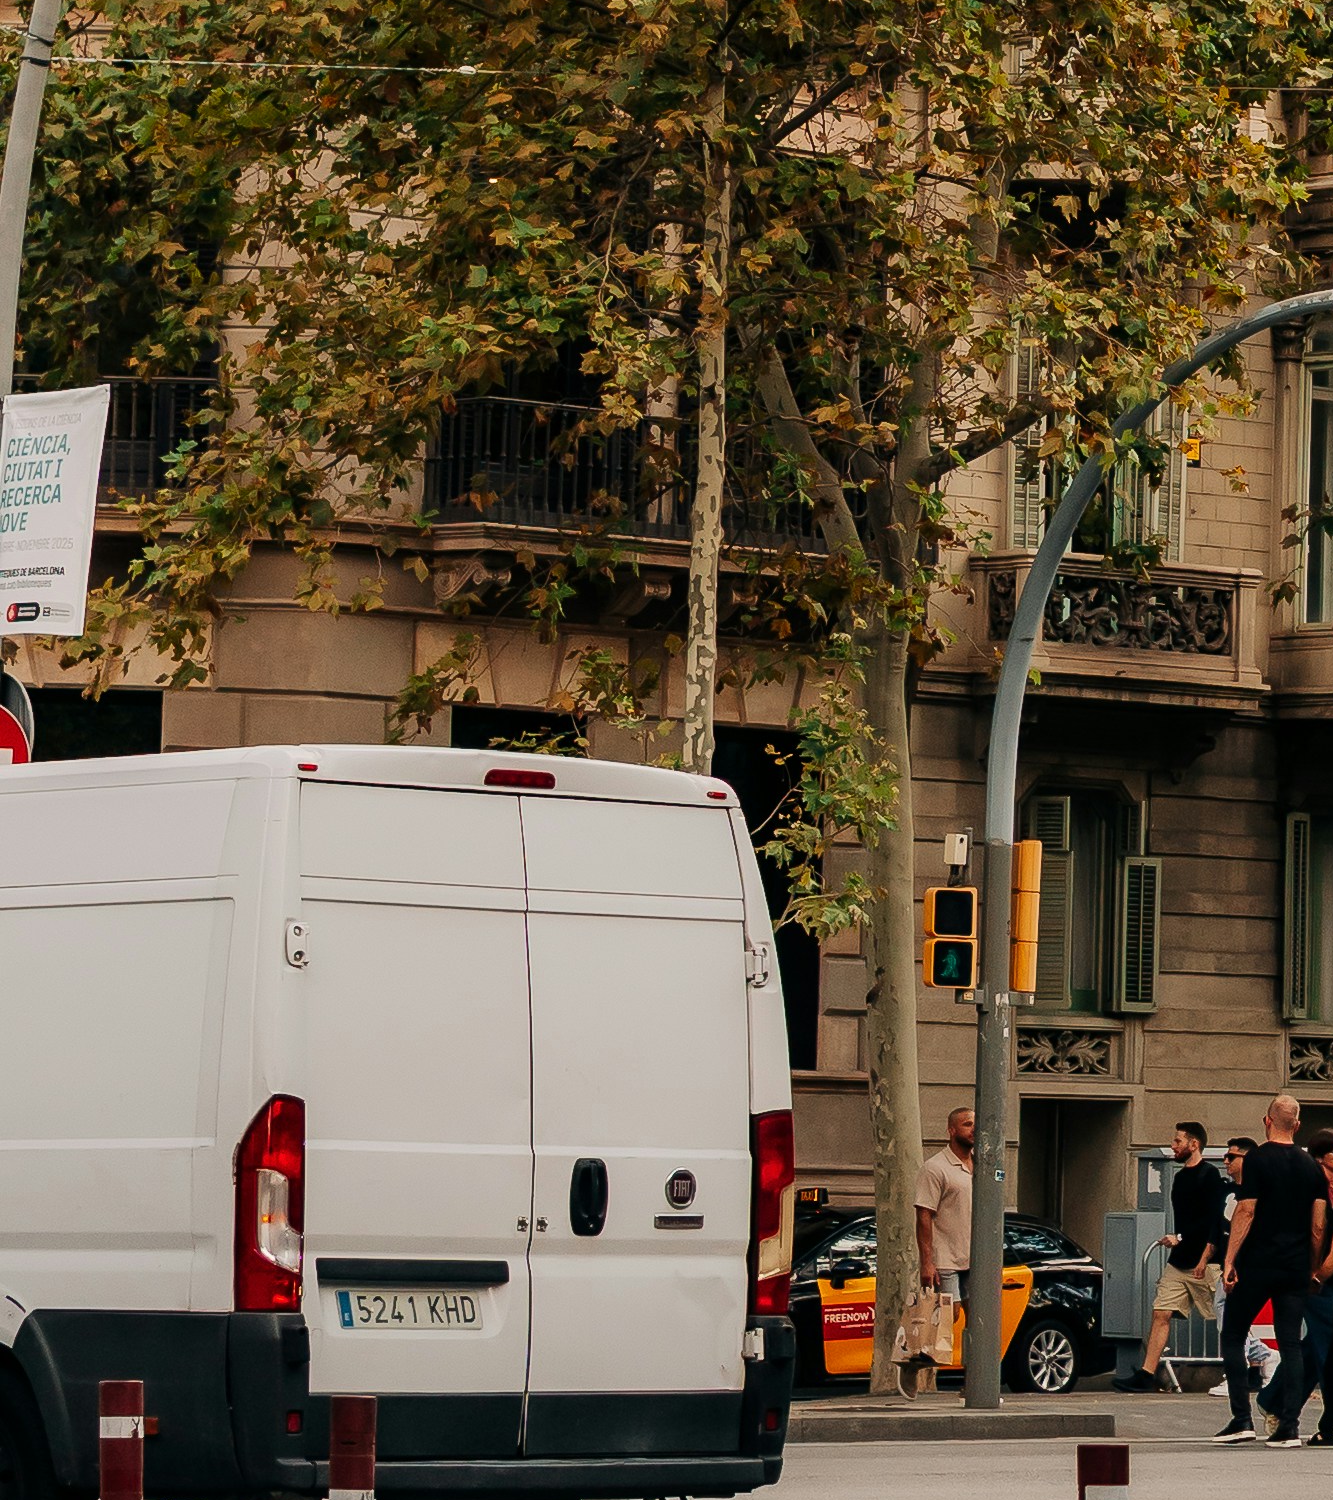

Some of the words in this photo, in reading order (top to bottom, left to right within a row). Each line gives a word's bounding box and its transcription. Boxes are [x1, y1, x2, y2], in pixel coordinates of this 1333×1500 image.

[7, 432, 71, 458] CIÈNCIA,
[3, 460, 54, 484] CIUTAT
[54, 459, 63, 478] I
[0, 511, 28, 533] OVE
[673, 1179, 691, 1198] FIAT
[356, 1295, 418, 1325] 5241
[429, 1295, 476, 1325] KHD
[824, 1312, 869, 1325] FREENOW
